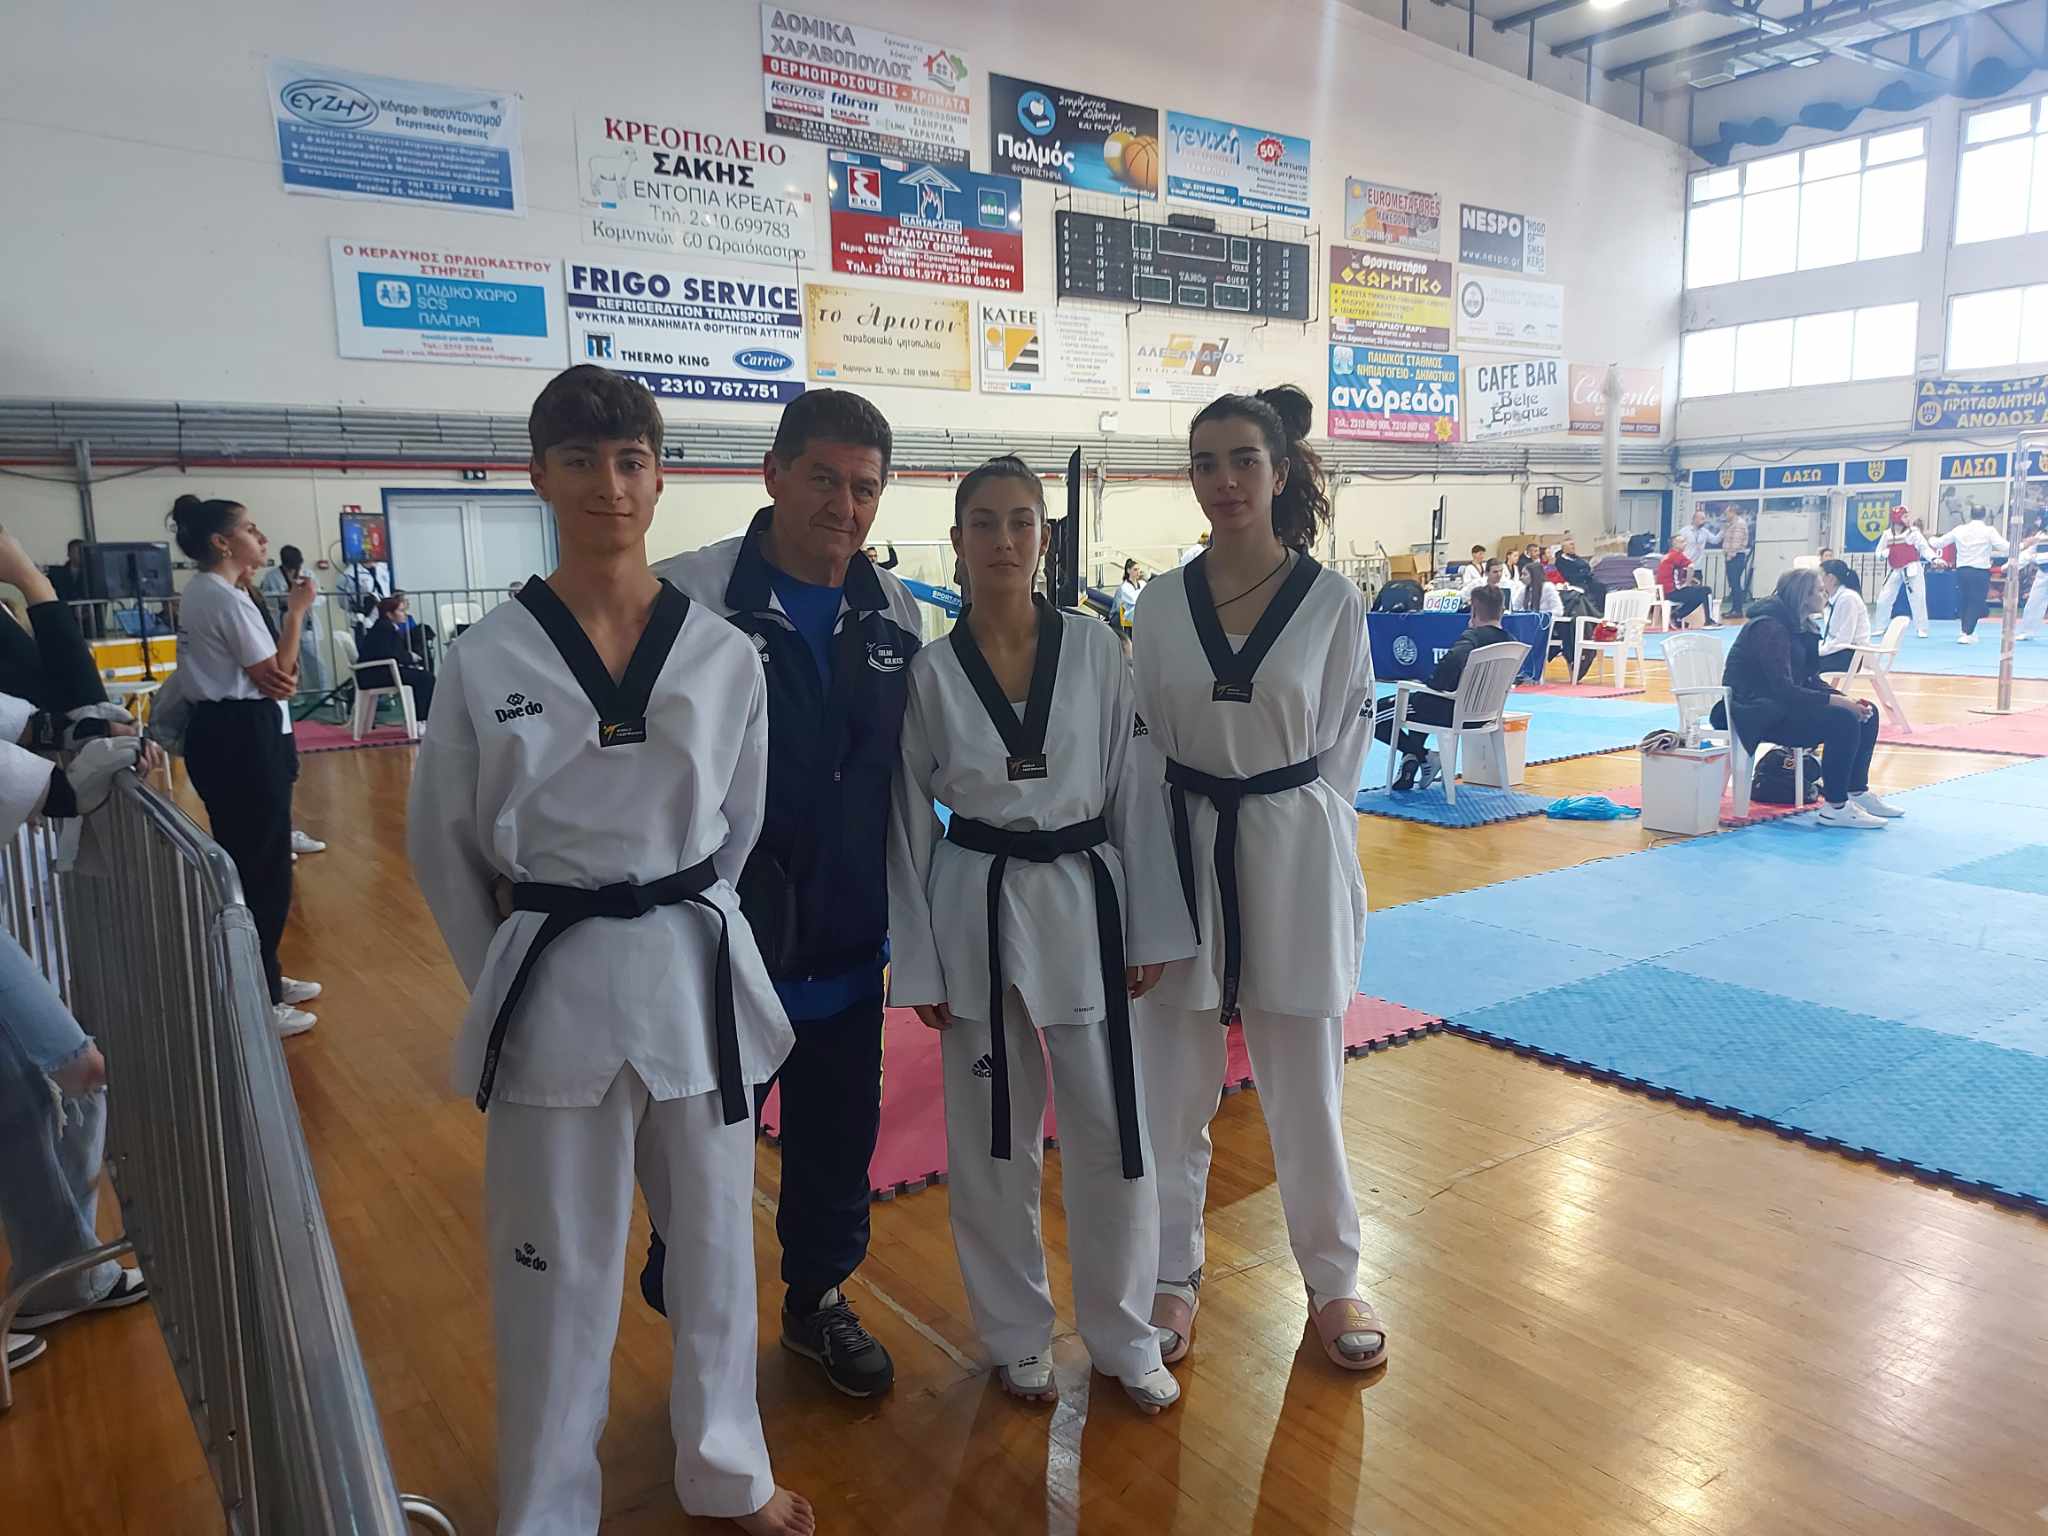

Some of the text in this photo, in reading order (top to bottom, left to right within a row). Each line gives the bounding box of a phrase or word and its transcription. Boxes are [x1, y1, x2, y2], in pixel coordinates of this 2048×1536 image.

[771, 10, 856, 46] ΔΟΜΙΚΑ
[771, 35, 912, 81] ΧΑΡΑΒΟΠΟΥΛΟΣ
[771, 59, 899, 97] ΘΕΡΜΟΠΡΟΣΟΨΕΙΣ
[605, 117, 786, 166] ΚΡΕΟΠΩΛΕΙΟ
[998, 134, 1075, 173] Παλμός
[652, 152, 755, 188] ΣΑΚΗΣ
[634, 180, 799, 218] ΕΝΤΟΠΙΑ ΚΡΕΑΤΑ
[1462, 208, 1522, 237] NESPO
[708, 235, 806, 261] Ωραιόκαστρο
[888, 227, 970, 246] ΕΓΚΑΤΑΣΤΑΣΕΙΣ
[343, 245, 551, 273] Ο ΚΕΡΑΥΝΟΣ ΩΡΑΙΟΚΑΣΤΡΟΥ
[1362, 254, 1428, 275] Φροντιστήριο
[420, 264, 485, 280] ΣΤΗΡΙΖΕΙ
[1340, 266, 1443, 295] ΘΕΩΡΗΤΙΚΟ
[416, 284, 518, 303] ΠΑΙΔΙΚΟ ΧΩΡΙΟ
[572, 265, 798, 310] FRIGO SERVICE
[416, 297, 448, 311] SOS
[597, 298, 780, 324] REFRIGERATION TRANSPORT
[819, 308, 842, 323] το
[575, 311, 625, 325] ΨΥΚΤΙΚΑ
[628, 316, 701, 332] ΜΗΧΑΝΗΜΑΤΑ
[703, 323, 757, 337] ΦΟΡΤΗΓΩΝ
[621, 350, 711, 367] THERMO KING
[740, 353, 787, 369] Carrier
[1137, 346, 1245, 364] ΑΛΕΞΑΝΔΡΟΣ
[1368, 352, 1443, 369] ΠΑΙΔΙΚΟΣ ΣΤΑΘΜΟΣ
[661, 378, 779, 399] 2310 767.751
[1478, 361, 1558, 392] CAFE BAR
[1331, 378, 1459, 422] ανδρεάδη
[1956, 409, 2036, 428] ΑΝΟΔΟΣ
[1782, 469, 1821, 483] ΔΑΣΩ
[1950, 457, 1998, 478] ΔΑΣΩ
[1444, 598, 1459, 610] 36
[494, 701, 544, 723] Daedo
